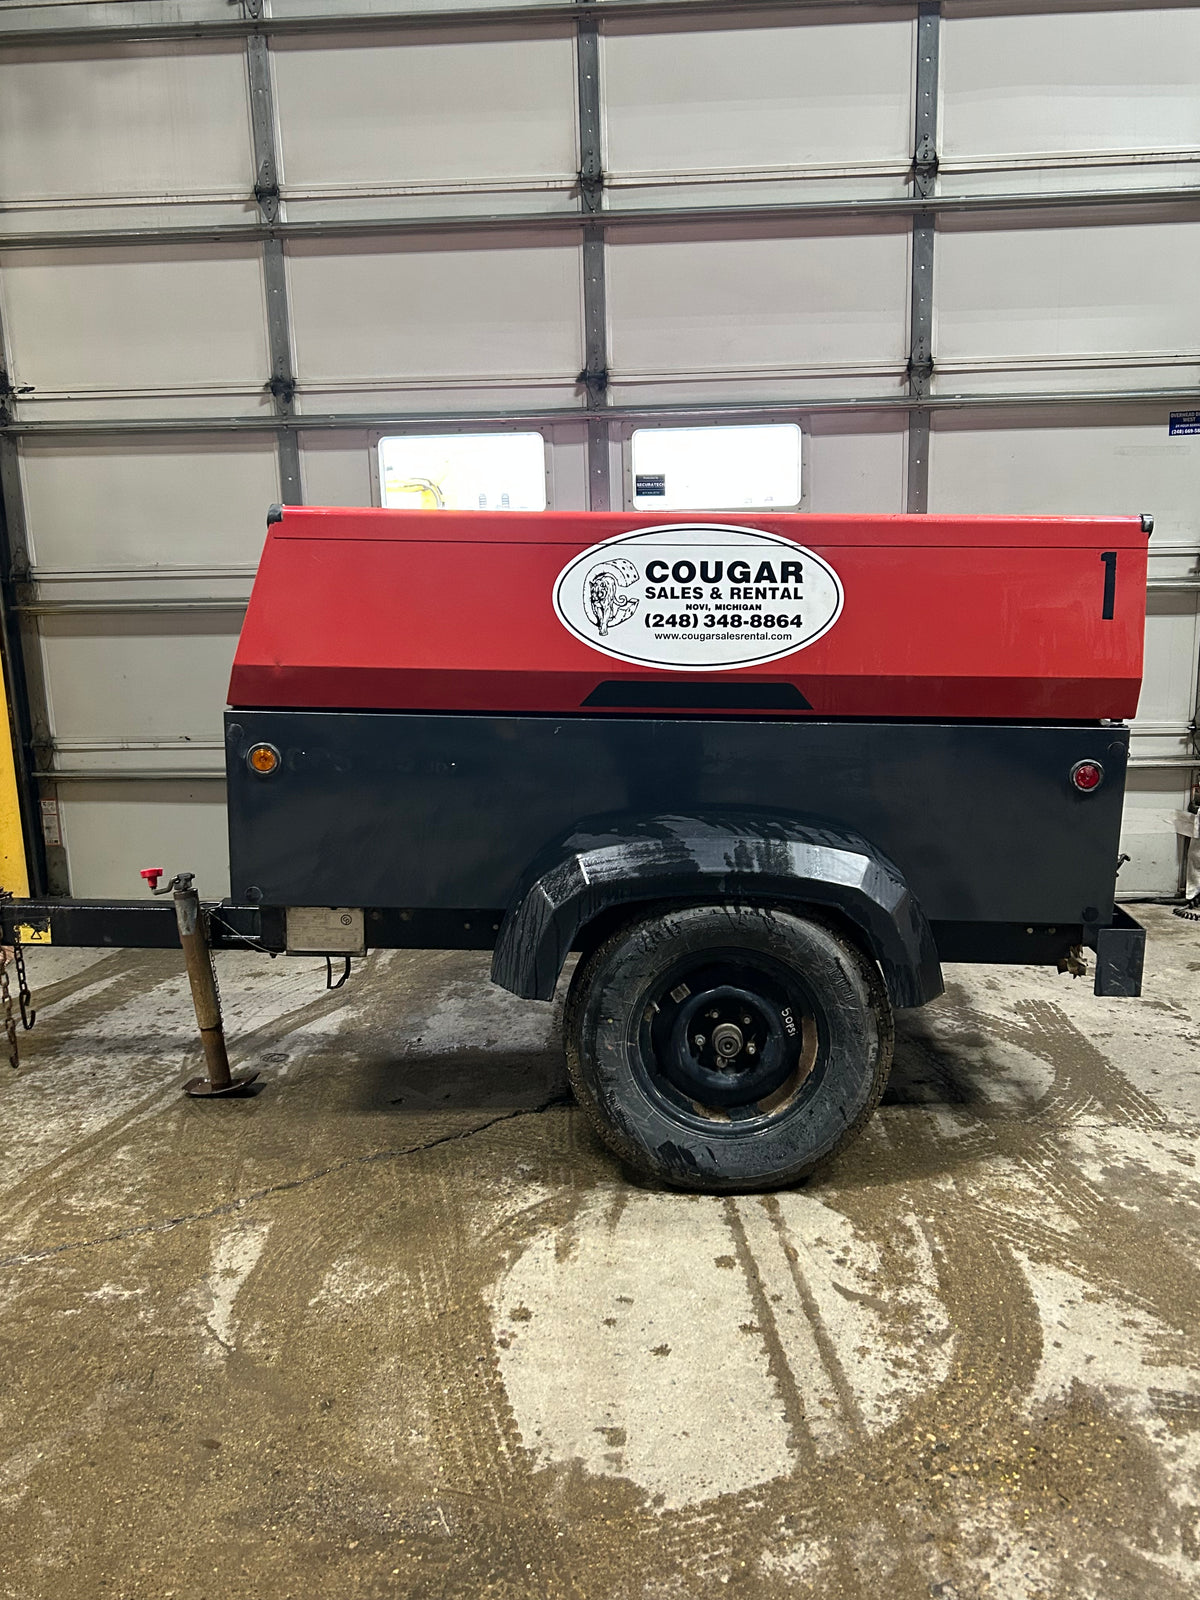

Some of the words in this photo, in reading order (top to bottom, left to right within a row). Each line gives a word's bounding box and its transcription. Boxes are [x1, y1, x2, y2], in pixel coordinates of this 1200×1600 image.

[645, 560, 804, 584] COUGAR
[645, 586, 704, 600] SALES
[709, 586, 723, 600] &
[730, 586, 804, 600] RENTAL
[1100, 551, 1117, 620] 1
[685, 603, 712, 612] NOVI,
[714, 603, 762, 611] MICHIGAN
[644, 613, 699, 629] (248)
[703, 613, 803, 629] 348-8864
[653, 632, 793, 643] www.cougarsalesrental.com
